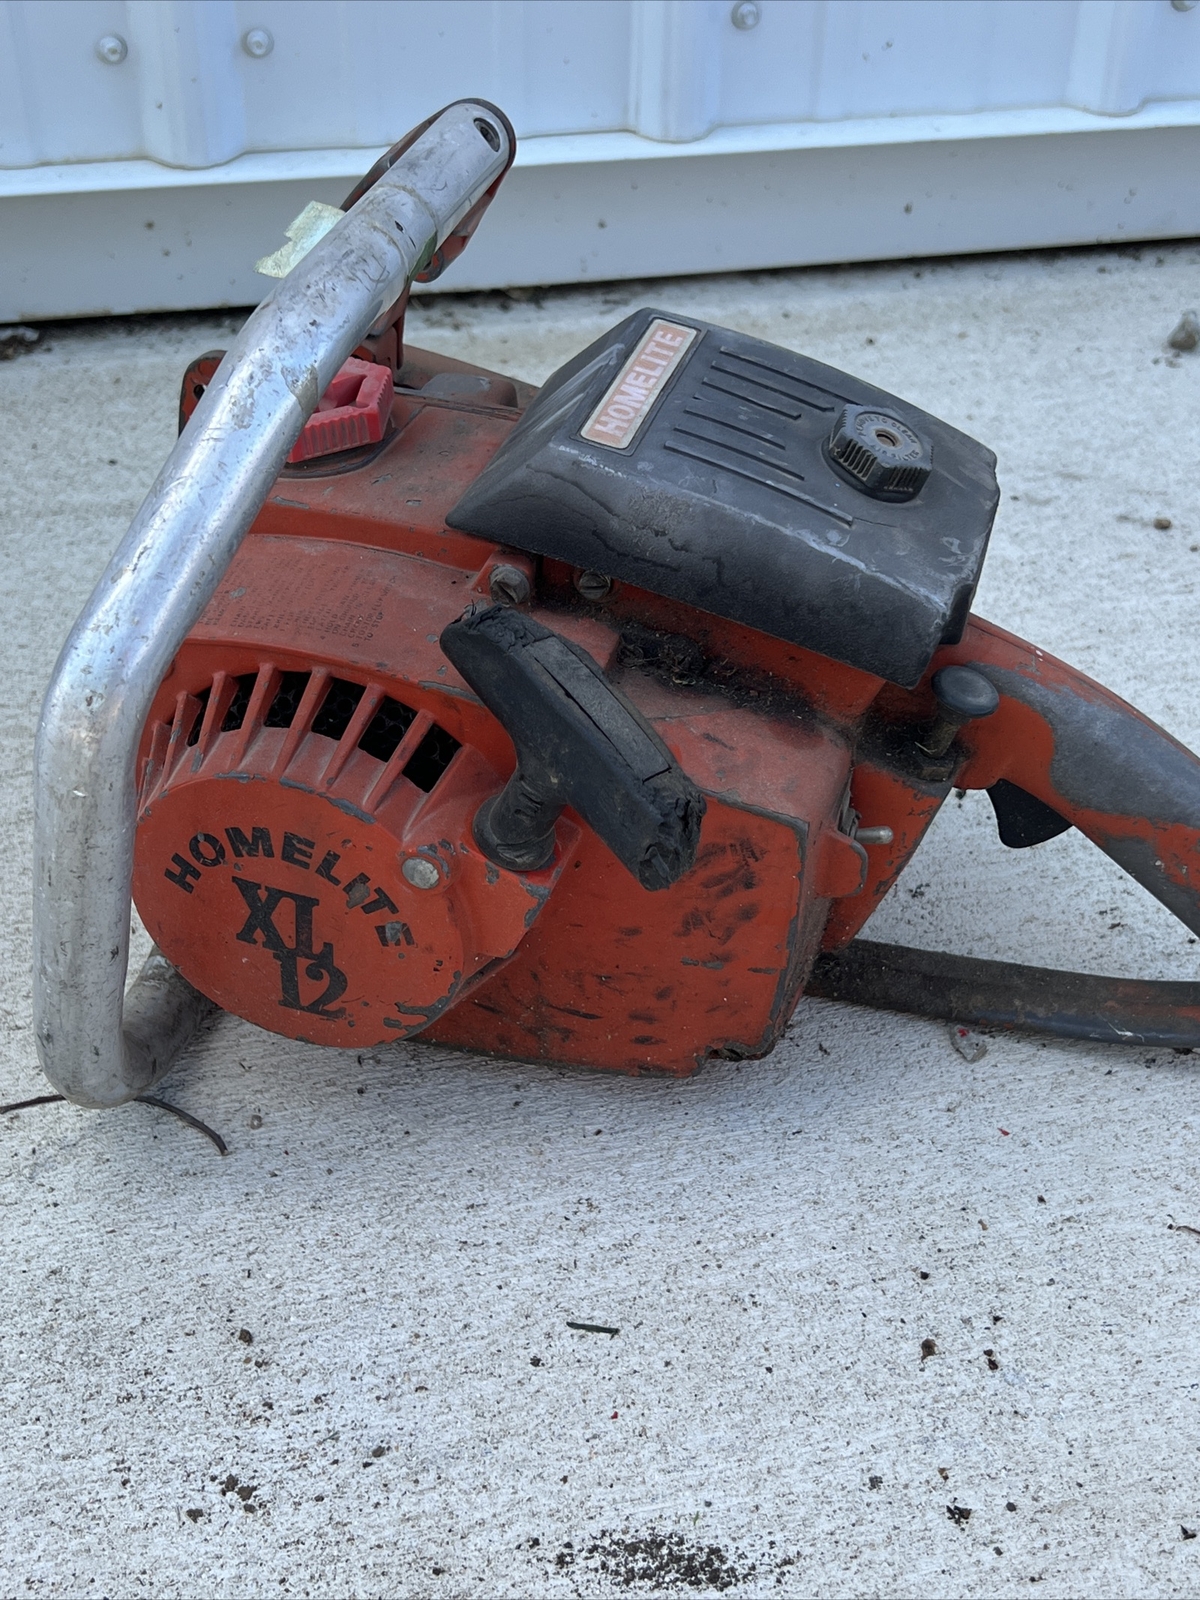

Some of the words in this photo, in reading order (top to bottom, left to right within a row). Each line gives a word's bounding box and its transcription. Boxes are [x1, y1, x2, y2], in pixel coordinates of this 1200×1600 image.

[594, 330, 683, 438] HOMELITE
[891, 422, 918, 444] CLEAN
[164, 826, 415, 947] HOMELITE
[231, 875, 320, 961] XL
[272, 941, 348, 1018] 12
